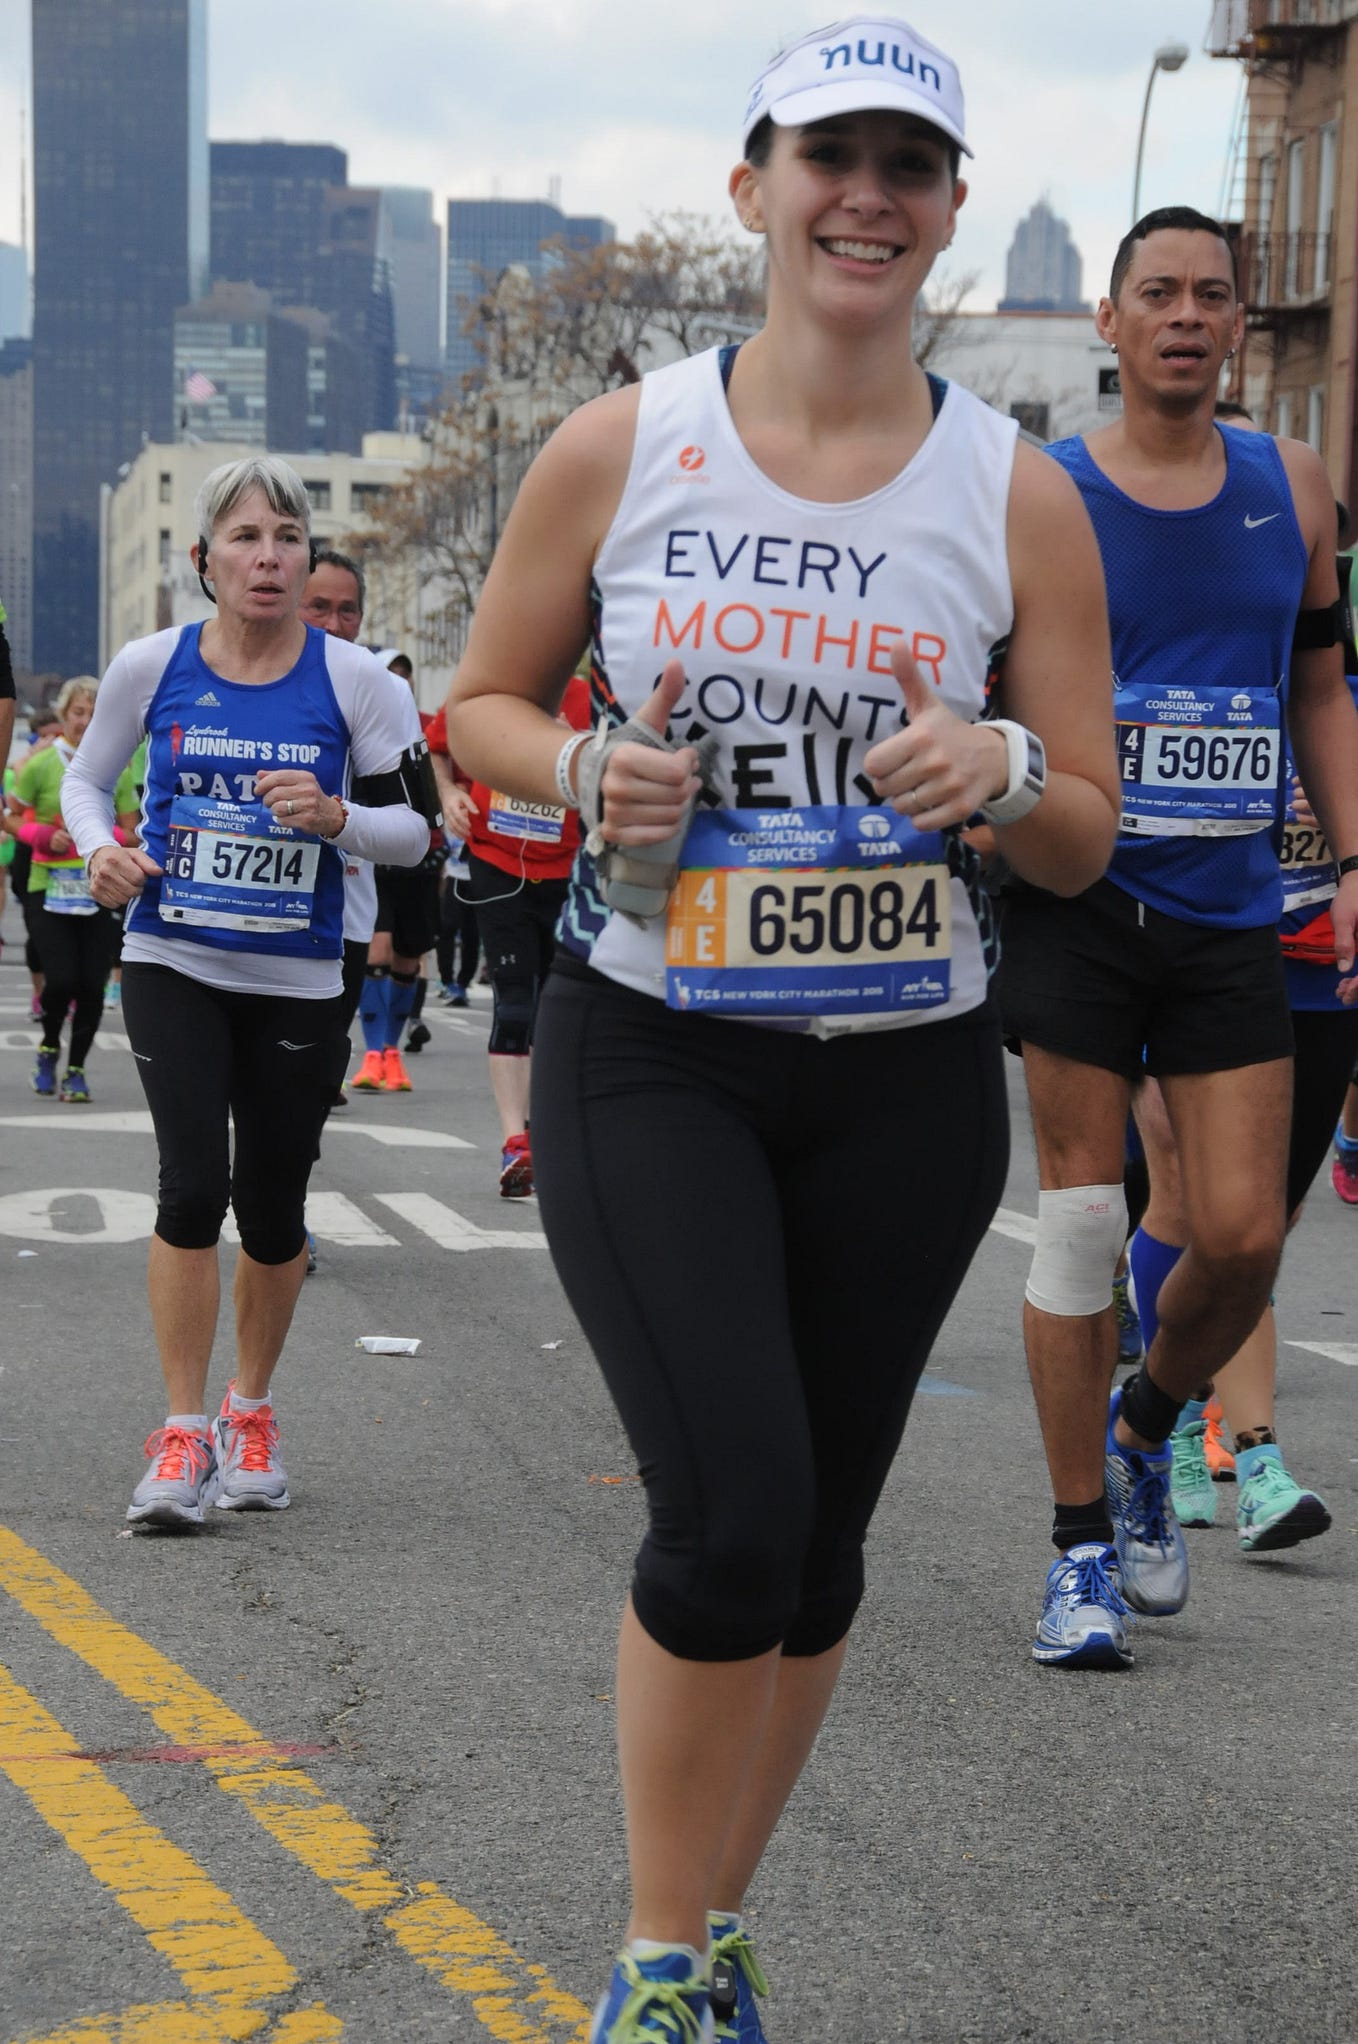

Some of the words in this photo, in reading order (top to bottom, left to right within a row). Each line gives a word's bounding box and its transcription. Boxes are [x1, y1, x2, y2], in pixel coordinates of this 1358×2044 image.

[820, 39, 941, 92] nuun
[665, 530, 887, 598] EVERY
[653, 598, 947, 685] MOTHER
[1166, 690, 1195, 700] TATA
[653, 672, 911, 741] COUNT
[1145, 700, 1215, 712] CONSULTANCY
[1157, 712, 1202, 722] SERVICES
[1227, 712, 1253, 721] TATA
[1124, 729, 1139, 751] 4
[183, 737, 273, 760] RUNNER'S
[277, 743, 321, 764] STOP
[1157, 735, 1271, 781] 59676
[1123, 757, 1137, 780] E
[198, 808, 257, 824] CONSULTANCY
[216, 802, 241, 813] TATA
[207, 819, 245, 832] SERVICES
[757, 813, 804, 828] TATA
[268, 825, 294, 835] TATA
[728, 829, 837, 846] CONSULTANCY
[181, 833, 193, 852] 4
[858, 841, 902, 856] TATA
[212, 841, 303, 885] 57214
[747, 847, 818, 863] SERVICES
[178, 857, 191, 878] C
[232, 898, 262, 907] MARATHON
[695, 877, 717, 913] 4
[750, 879, 941, 956] 65084
[696, 925, 715, 961] E
[695, 989, 720, 1000] TCS
[723, 991, 747, 1000] NEW
[750, 990, 777, 1000] YORK
[778, 990, 801, 999] CITY
[803, 988, 859, 998] MARATHON
